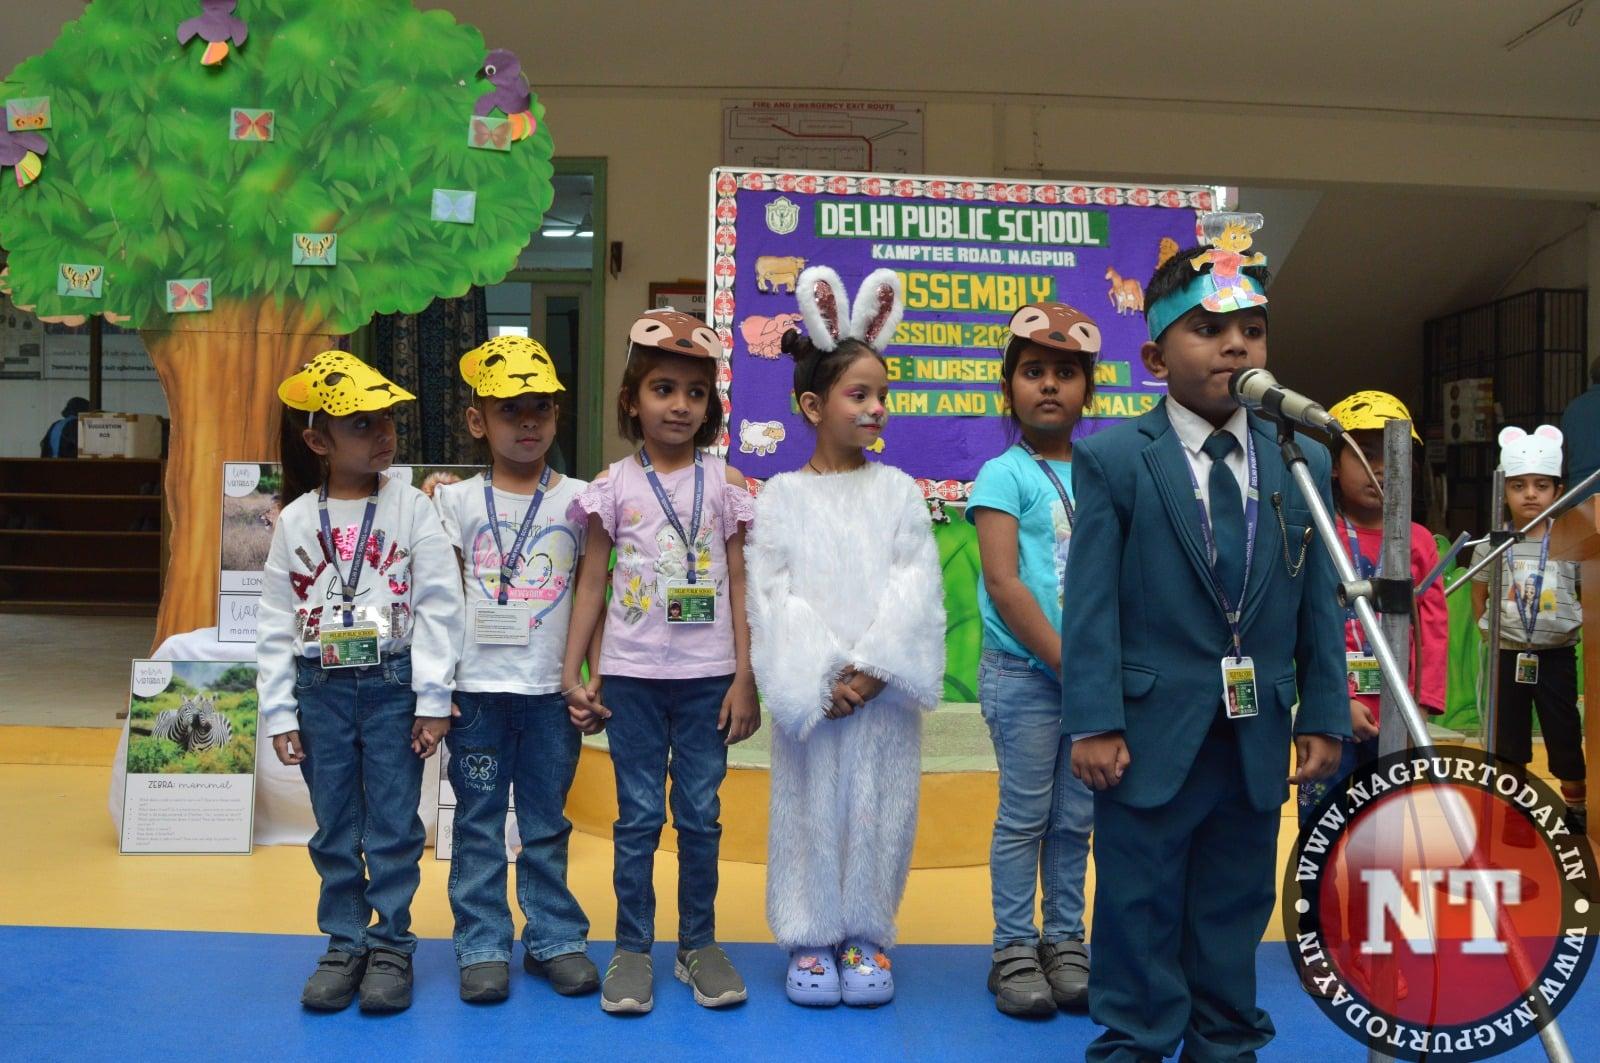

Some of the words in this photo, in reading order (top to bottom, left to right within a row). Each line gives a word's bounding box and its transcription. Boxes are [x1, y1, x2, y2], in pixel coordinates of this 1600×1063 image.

[752, 101, 770, 109] FIRE
[773, 102, 791, 110] AND
[846, 103, 865, 111] EXIT
[867, 104, 896, 112] ROUTE
[820, 203, 896, 237] DELHI
[901, 205, 992, 241] PUBLIC
[998, 209, 1100, 245] SCHOOL
[871, 243, 955, 263] KAMPTEE
[1008, 249, 1076, 268] NAGPUR
[916, 358, 1002, 381] NURSER
[935, 393, 986, 415] AND
